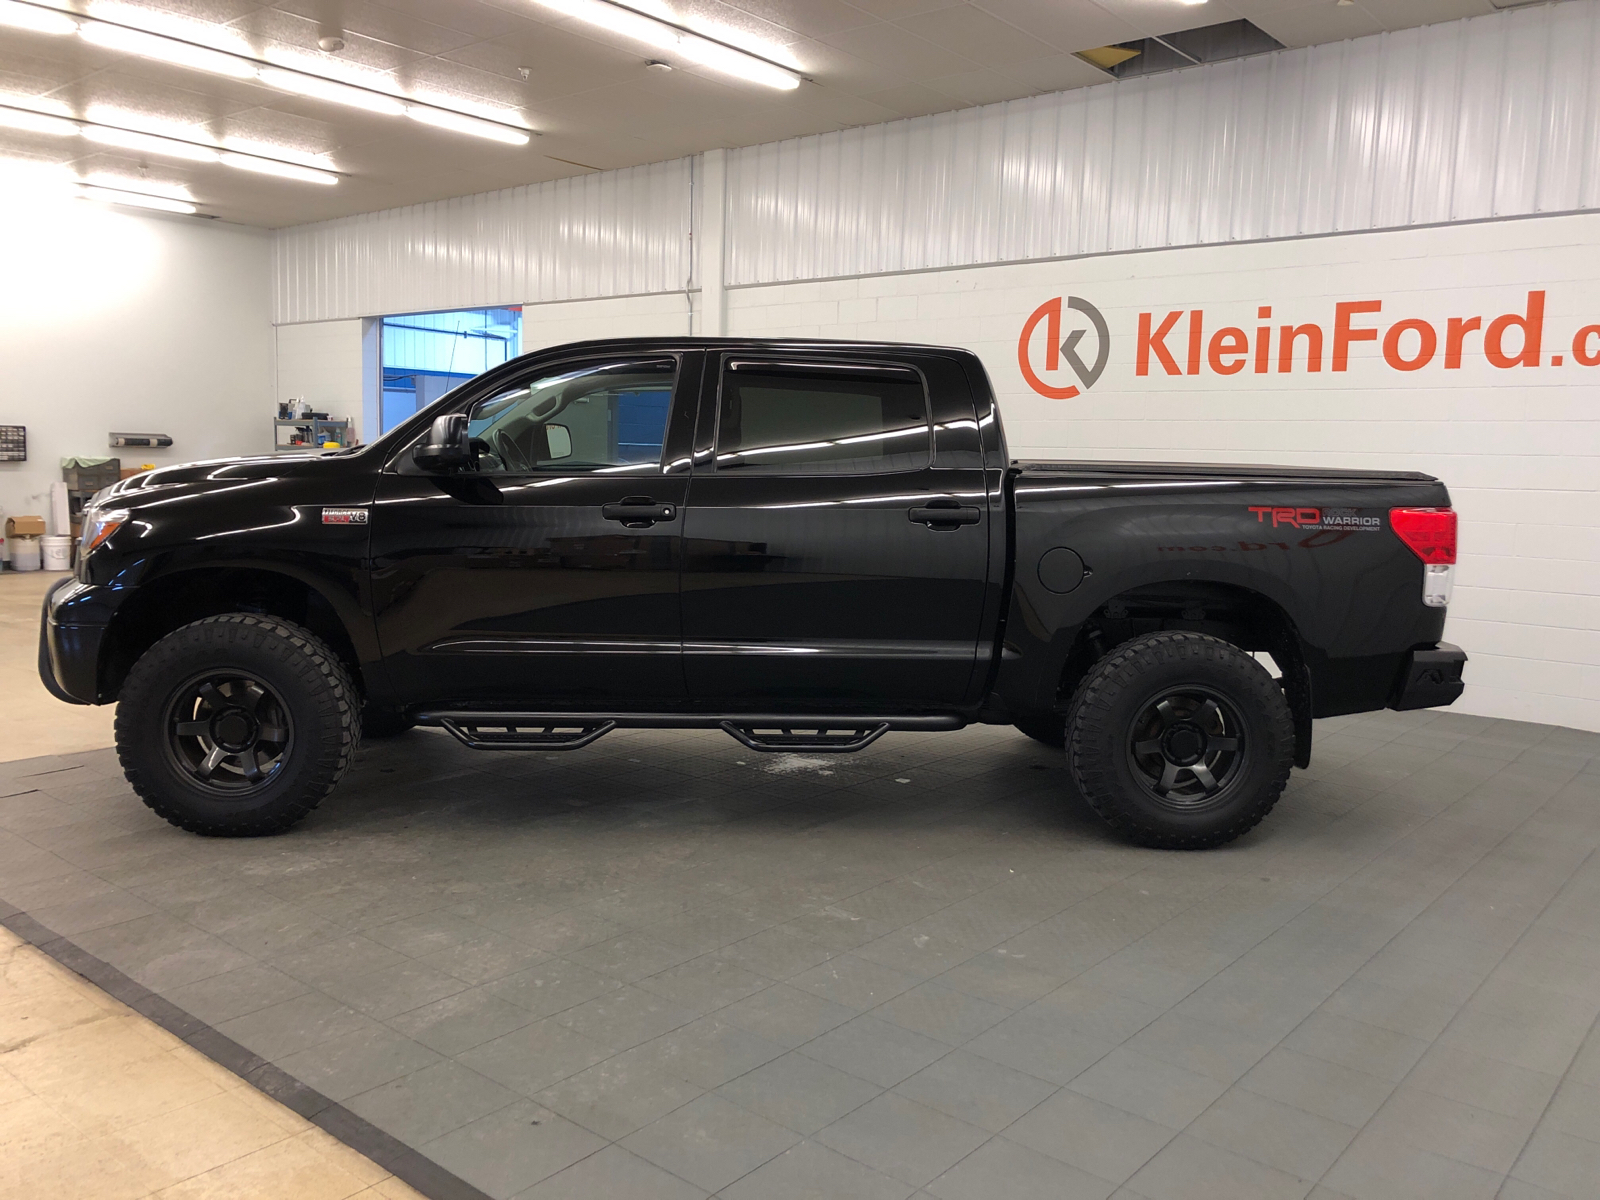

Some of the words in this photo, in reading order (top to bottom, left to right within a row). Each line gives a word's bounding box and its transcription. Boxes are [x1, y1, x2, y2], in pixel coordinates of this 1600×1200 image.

[350, 511, 366, 522] V8
[1248, 506, 1320, 528] TRD
[1323, 516, 1380, 526] WARRIOR
